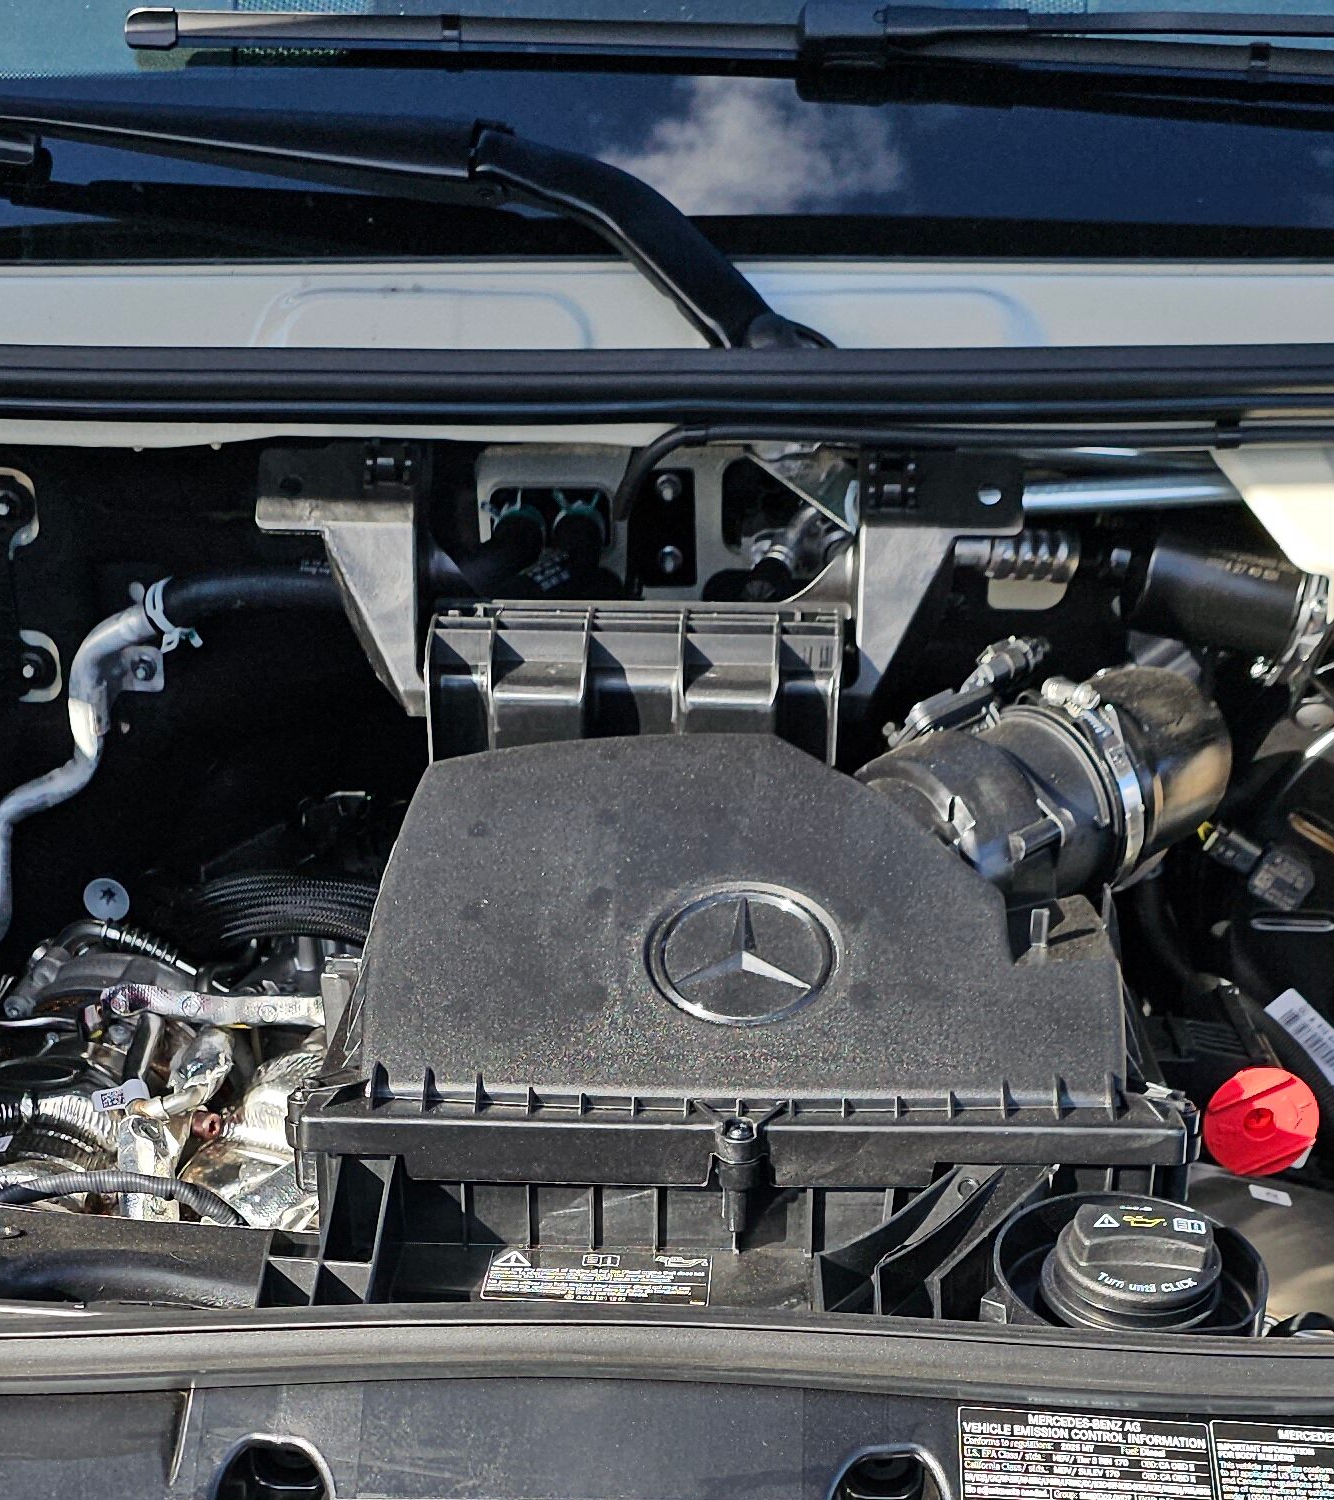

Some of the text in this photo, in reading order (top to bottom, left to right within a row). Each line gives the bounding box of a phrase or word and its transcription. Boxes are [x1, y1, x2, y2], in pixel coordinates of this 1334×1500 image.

[1097, 1271, 1198, 1293] Turn until CLICK
[1028, 1413, 1141, 1433] MERCEDES-BENZ AG
[962, 1421, 1207, 1449] VEHICLE EMISSION CONTROL INFORMATION
[963, 1437, 1000, 1446] Conforms
[1001, 1439, 1009, 1447] to
[981, 1449, 997, 1458] EPA
